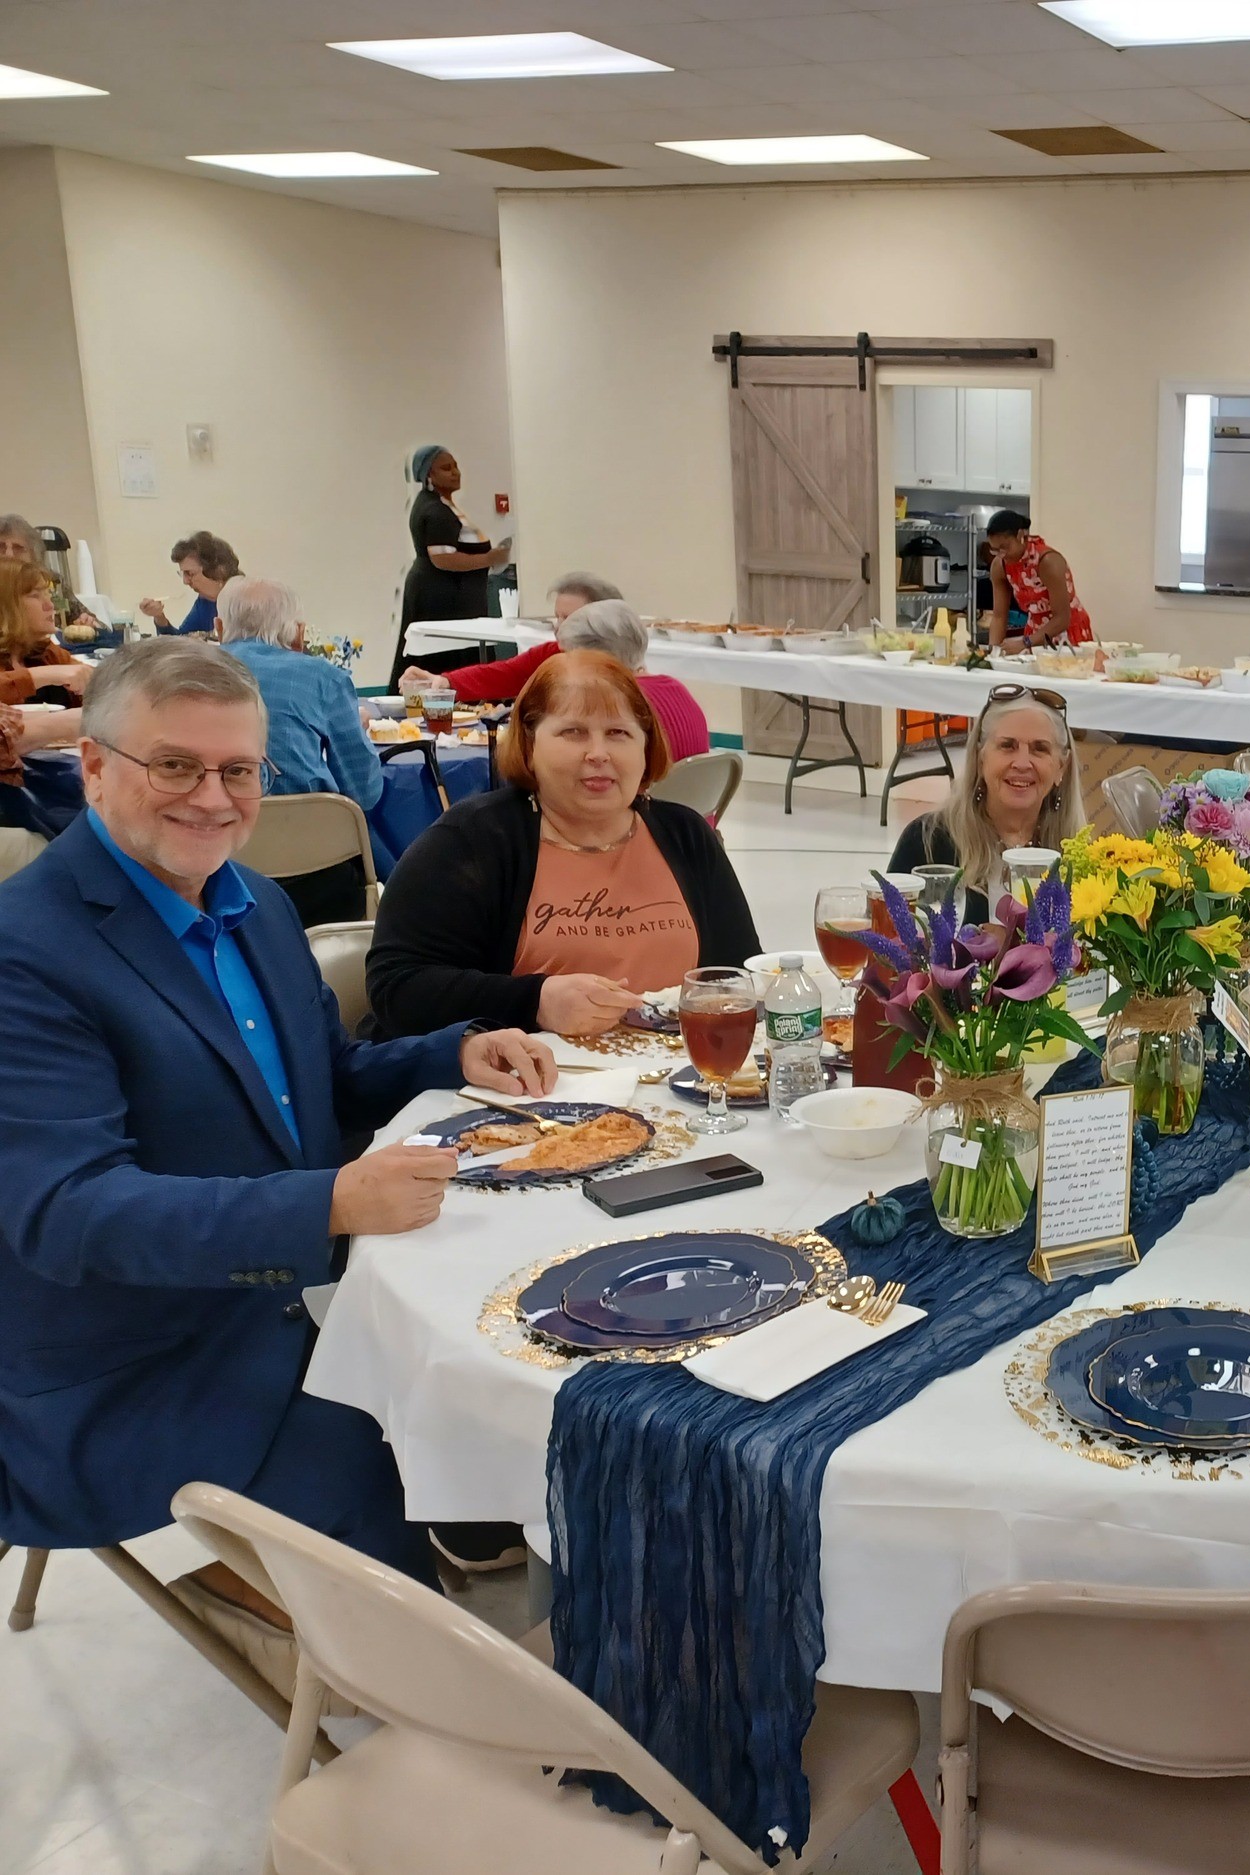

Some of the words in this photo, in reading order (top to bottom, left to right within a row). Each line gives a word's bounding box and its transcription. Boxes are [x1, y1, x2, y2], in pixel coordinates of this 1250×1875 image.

[533, 888, 682, 935] gather
[556, 925, 588, 937] AND
[594, 925, 610, 937] BE
[615, 919, 692, 937] GRATEFUL
